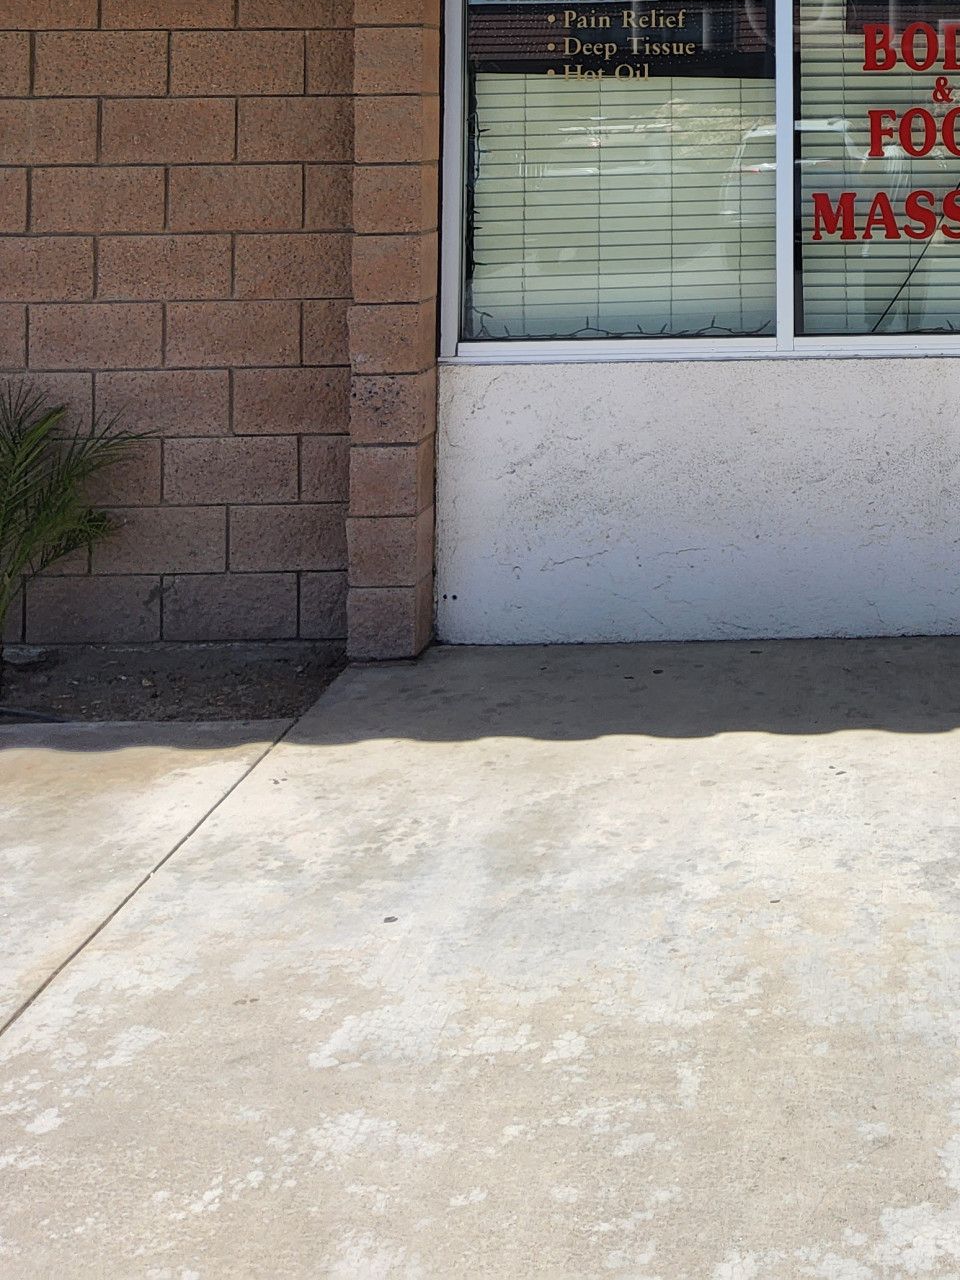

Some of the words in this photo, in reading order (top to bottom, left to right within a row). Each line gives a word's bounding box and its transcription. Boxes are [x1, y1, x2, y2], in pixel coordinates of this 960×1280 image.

[563, 9, 612, 29] Pain
[621, 8, 687, 29] Relief
[563, 37, 618, 61] Deep
[626, 36, 696, 56] Tissue
[563, 64, 607, 82] Hot
[614, 63, 650, 82] Oil
[932, 76, 954, 104] &
